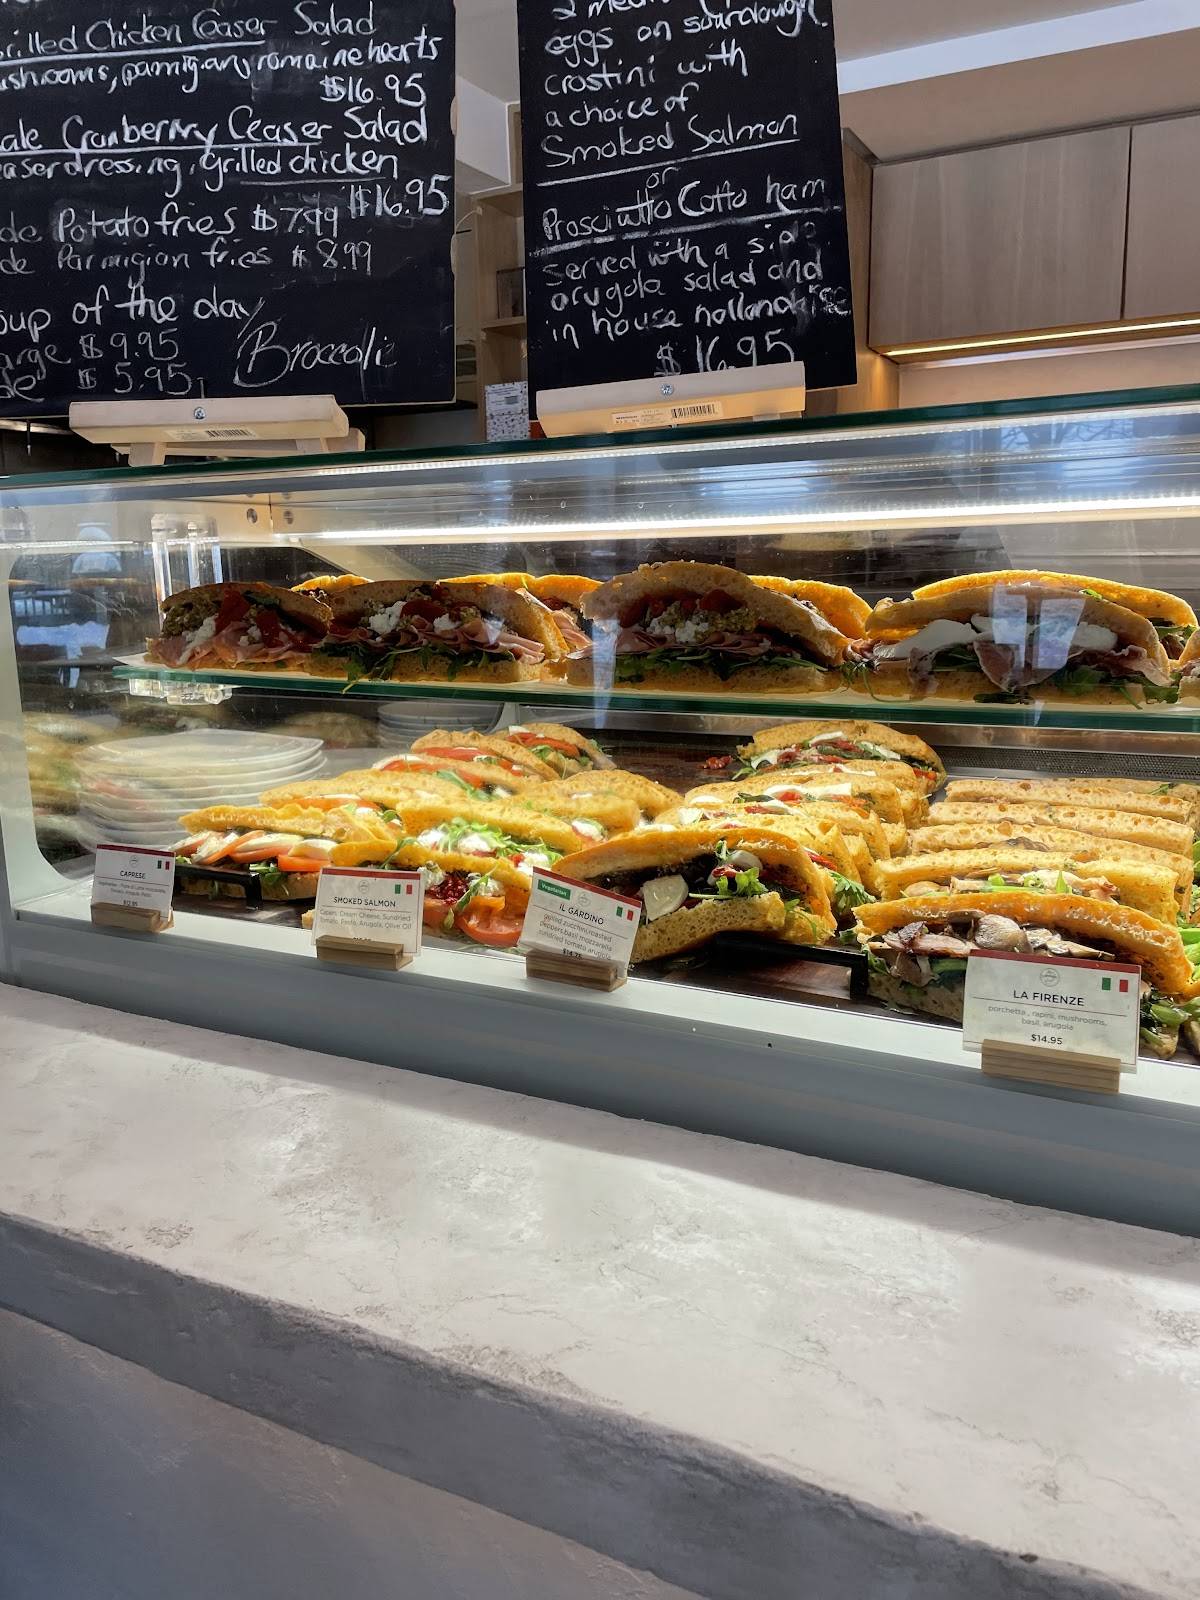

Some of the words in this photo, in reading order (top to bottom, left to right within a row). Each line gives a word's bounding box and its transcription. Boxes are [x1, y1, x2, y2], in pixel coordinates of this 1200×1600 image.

[294, 0, 376, 36] Salad
[545, 27, 613, 68] eggs
[637, 21, 671, 41] on
[544, 54, 655, 96] crostini
[676, 38, 748, 77] with
[319, 72, 427, 107] $16.95
[546, 110, 562, 127] a
[569, 97, 658, 126] choice
[664, 81, 699, 112] of
[0, 116, 43, 152] ale
[344, 104, 428, 146] Salad
[540, 121, 675, 167] Smoked
[687, 113, 798, 153] Salmon
[289, 142, 398, 180] chicken
[646, 166, 682, 190] or
[766, 174, 825, 213] ham
[57, 205, 150, 243] Potato
[154, 200, 238, 237] fries
[682, 260, 757, 293] salad
[767, 247, 824, 285] and
[715, 242, 730, 260] a
[72, 284, 110, 326] of
[114, 282, 179, 325] the
[545, 319, 580, 350] in
[591, 309, 684, 342] house
[333, 895, 363, 905] SMOKED
[364, 897, 396, 907] SALMON
[559, 902, 567, 913] IL
[568, 906, 605, 925] GARDINO
[1013, 989, 1029, 1000] LA
[1032, 991, 1086, 1007] FIRENZE
[1030, 1034, 1063, 1046] $14.95
